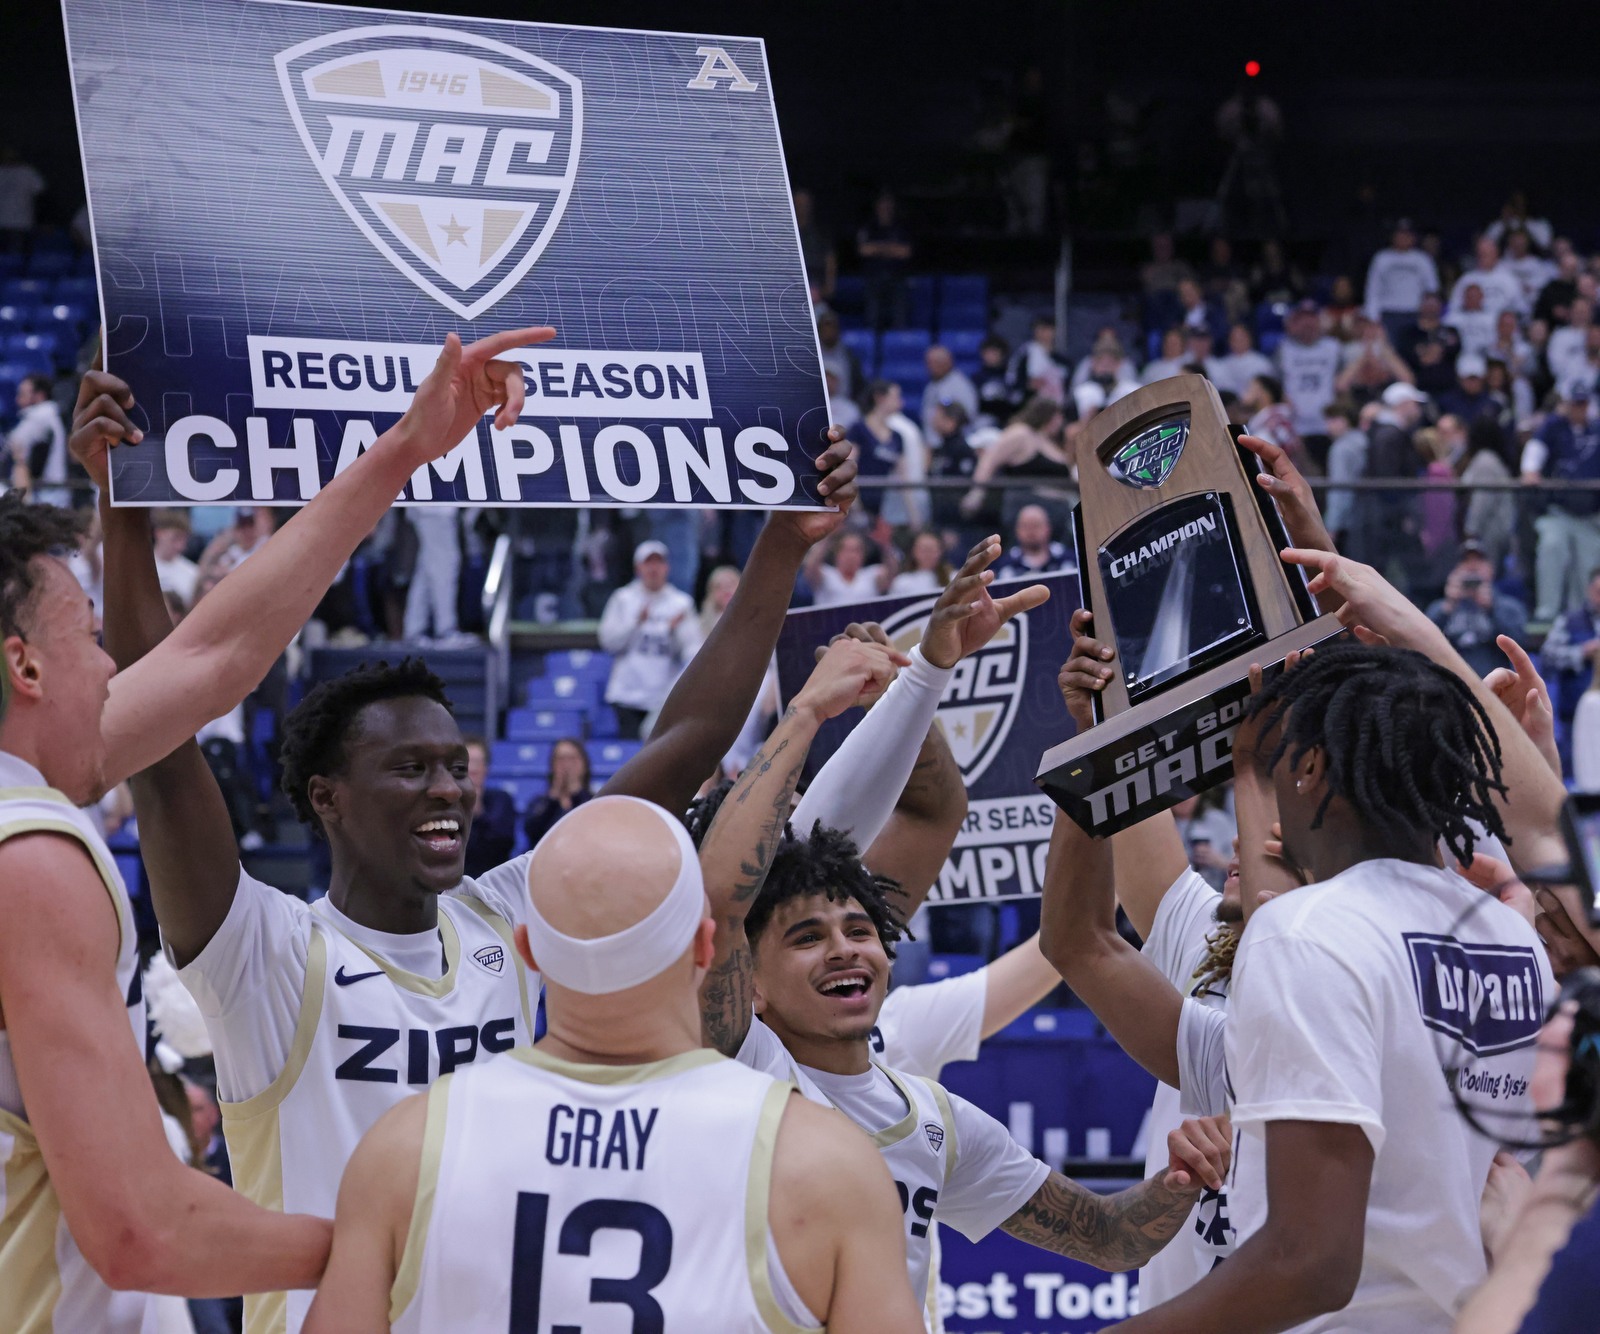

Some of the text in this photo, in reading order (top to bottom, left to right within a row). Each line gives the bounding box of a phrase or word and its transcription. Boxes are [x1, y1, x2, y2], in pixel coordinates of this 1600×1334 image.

[397, 69, 469, 96] 1946
[687, 46, 759, 92] A
[323, 115, 566, 188] MAC
[262, 350, 420, 393] REGUL
[164, 415, 795, 504] CHAMPIONS
[1109, 511, 1217, 579] CHAMPION
[947, 652, 1014, 702] AC
[1115, 696, 1250, 775] GET SO
[987, 804, 1057, 832] SEAS
[479, 951, 504, 966] MAC
[1432, 951, 1536, 1026] bryant
[1502, 1073, 1530, 1100] Syste
[545, 1104, 659, 1171] GRAY
[927, 1131, 943, 1143] MAC
[508, 1191, 673, 1334] 13
